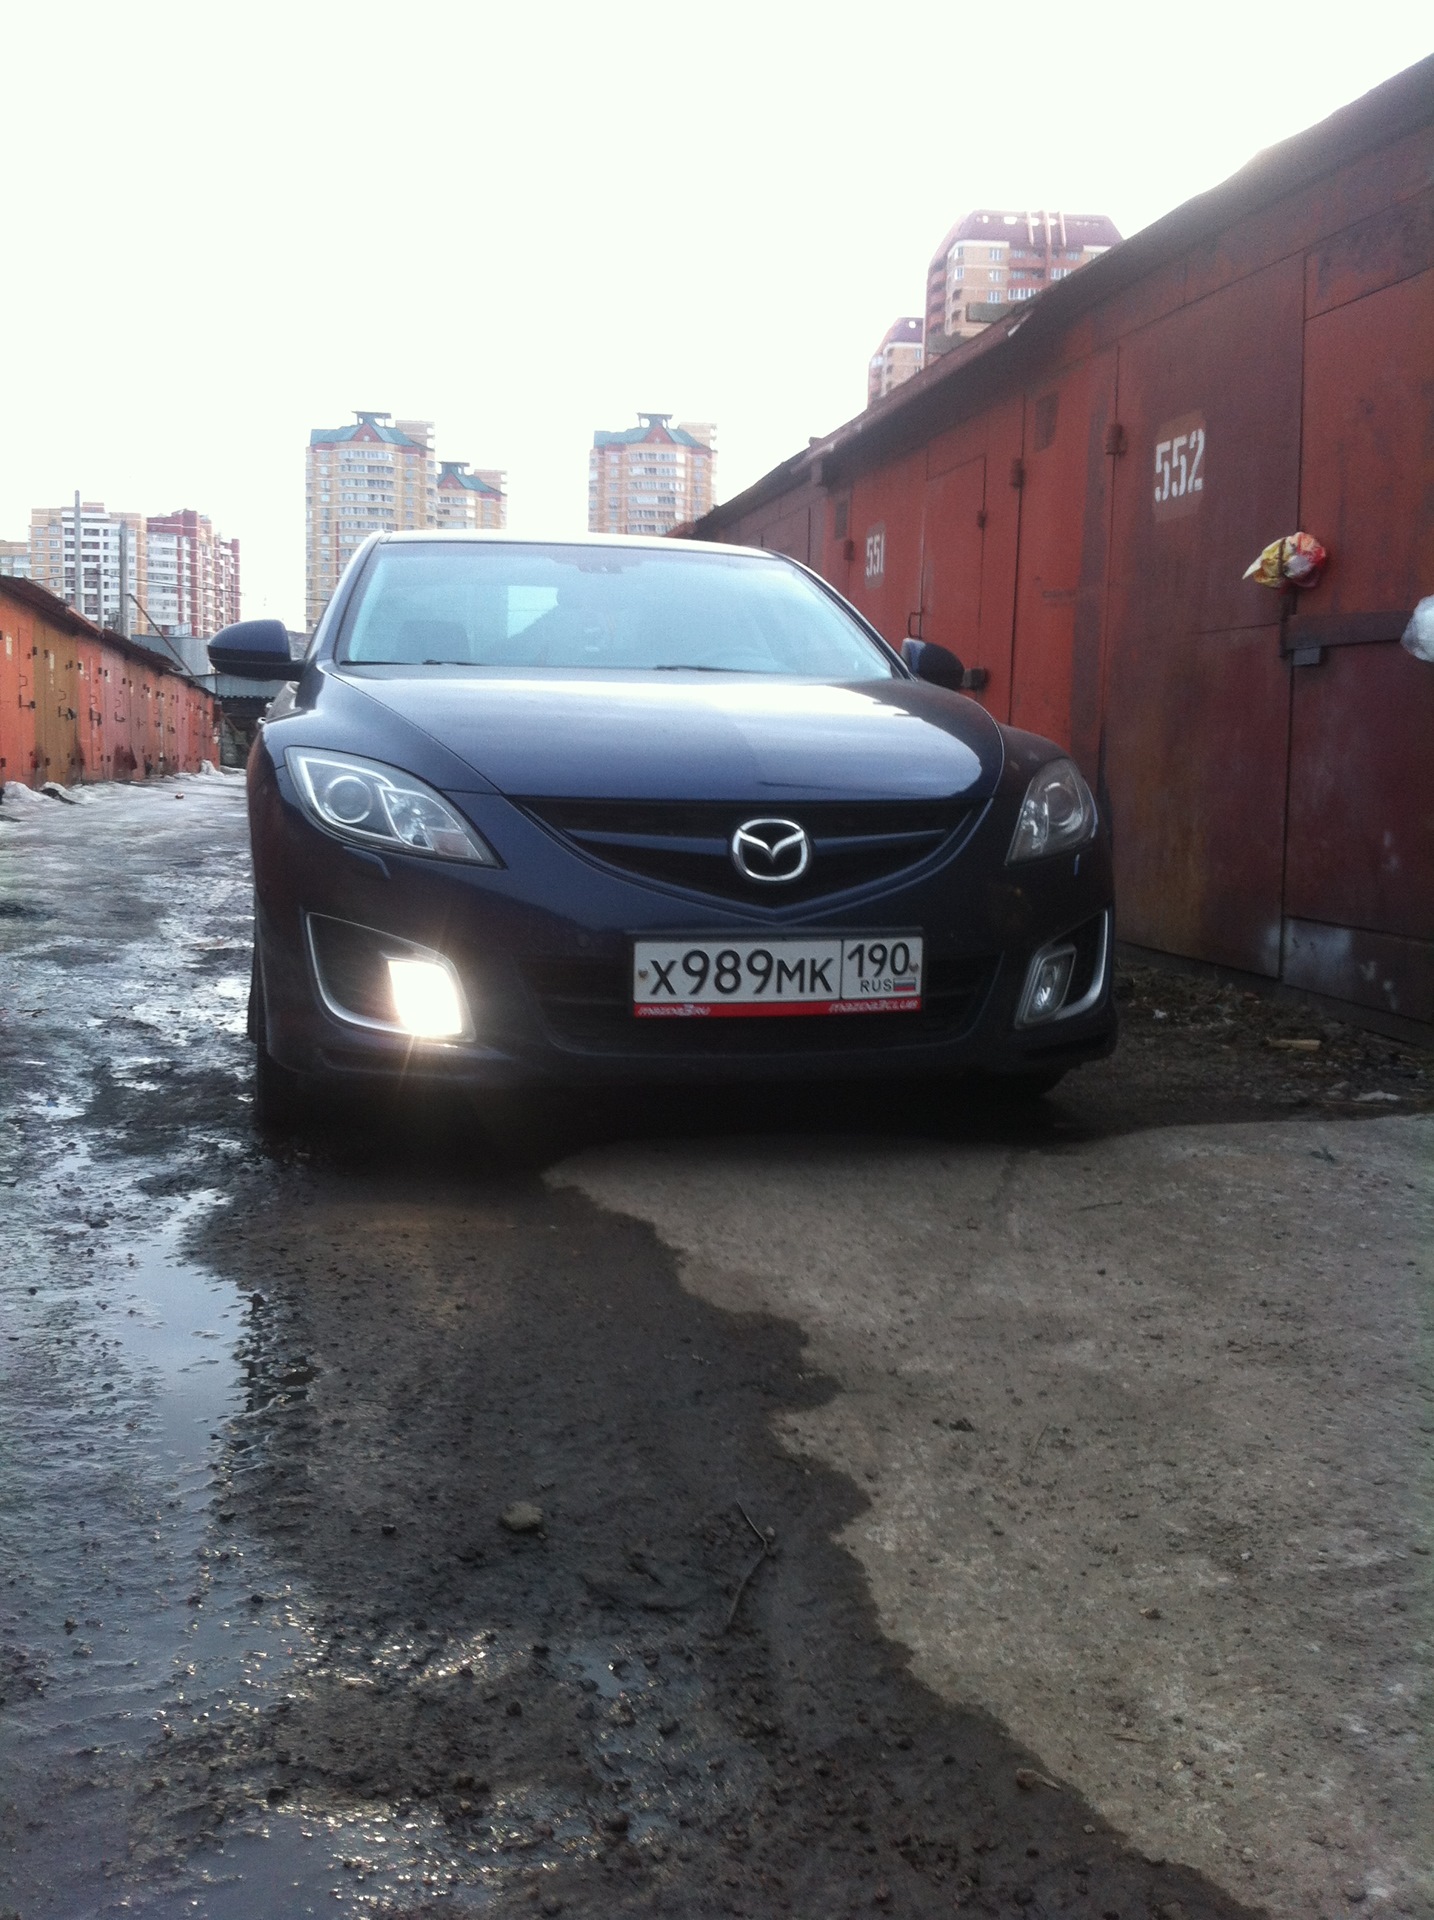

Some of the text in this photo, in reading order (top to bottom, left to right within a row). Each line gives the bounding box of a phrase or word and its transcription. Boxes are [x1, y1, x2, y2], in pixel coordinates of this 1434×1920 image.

[1154, 428, 1205, 503] 552
[865, 533, 885, 577] 551
[847, 942, 910, 978] 190
[860, 979, 892, 993] RUS
